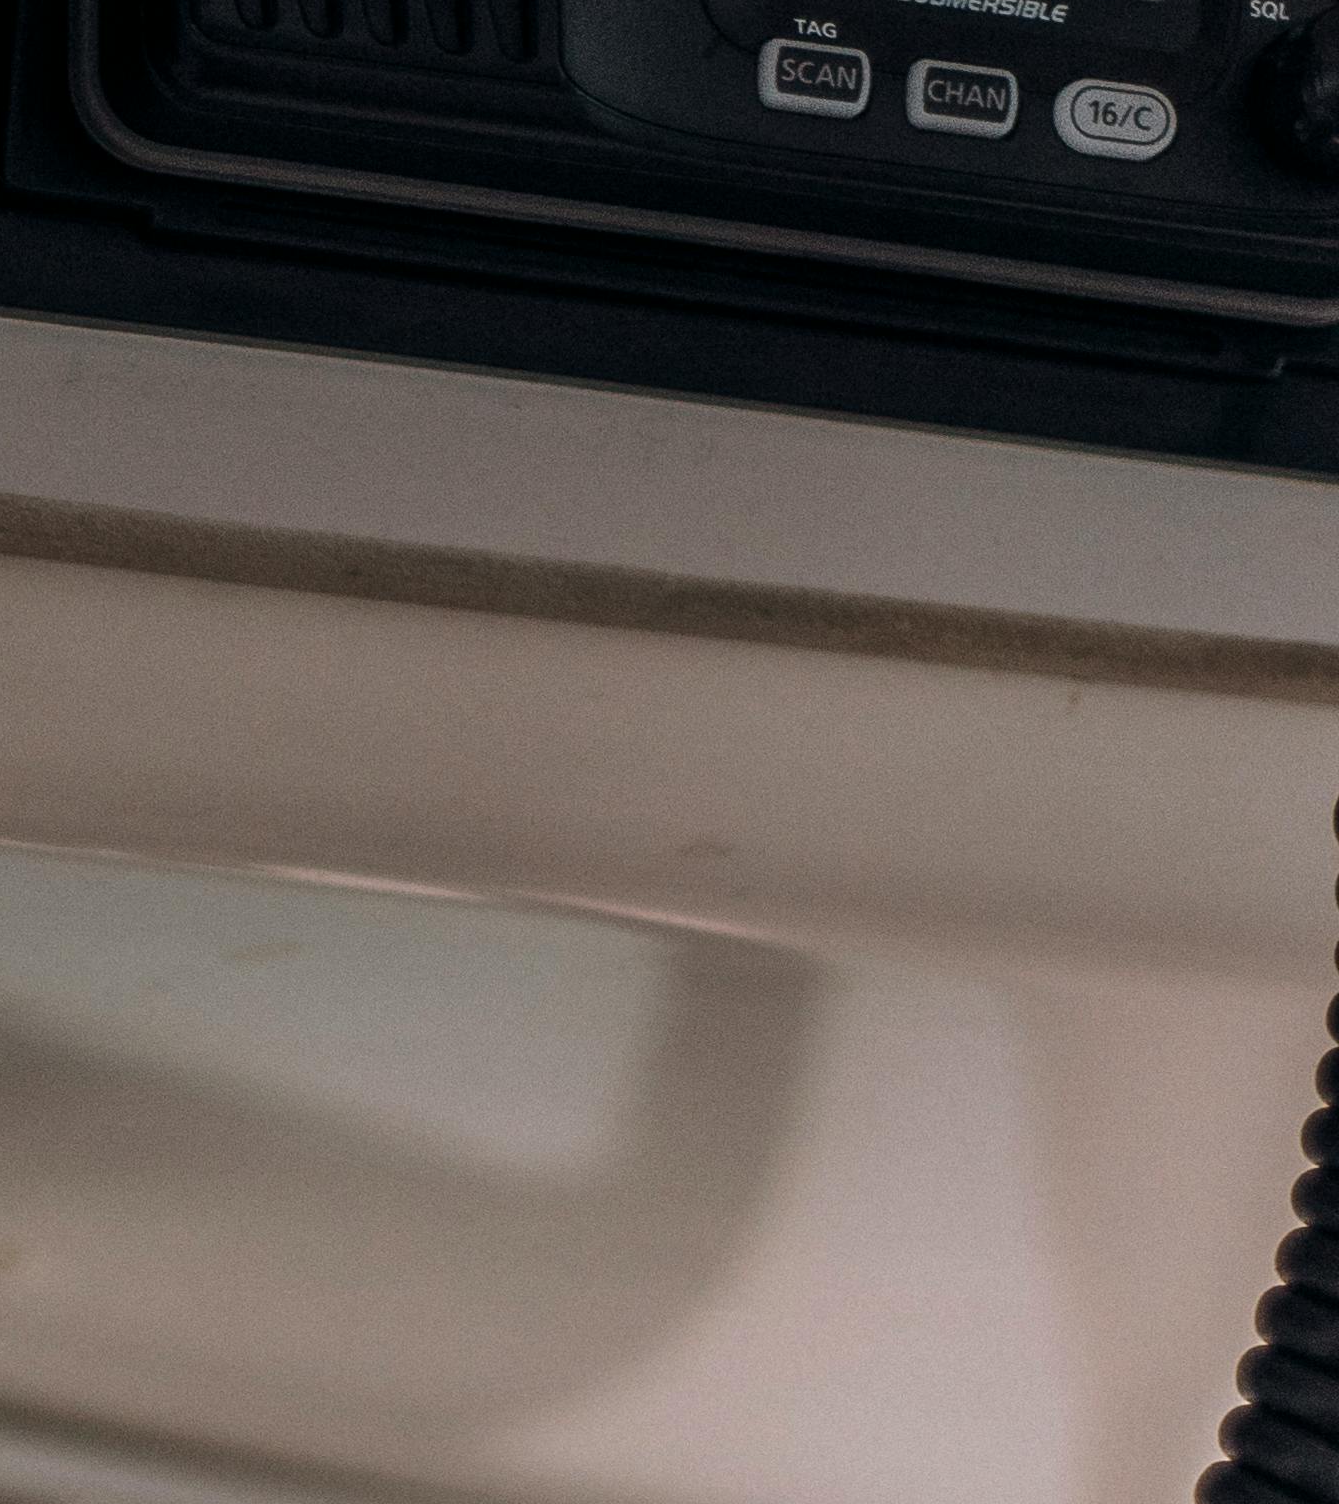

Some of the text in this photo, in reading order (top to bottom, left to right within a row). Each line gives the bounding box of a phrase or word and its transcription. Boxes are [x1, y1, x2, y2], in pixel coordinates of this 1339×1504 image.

[1250, 0, 1288, 20] SQL
[795, 18, 838, 39] TAG
[781, 58, 858, 90] SCAN
[926, 80, 1007, 111] CHAN
[1089, 100, 1152, 131] 16/C
